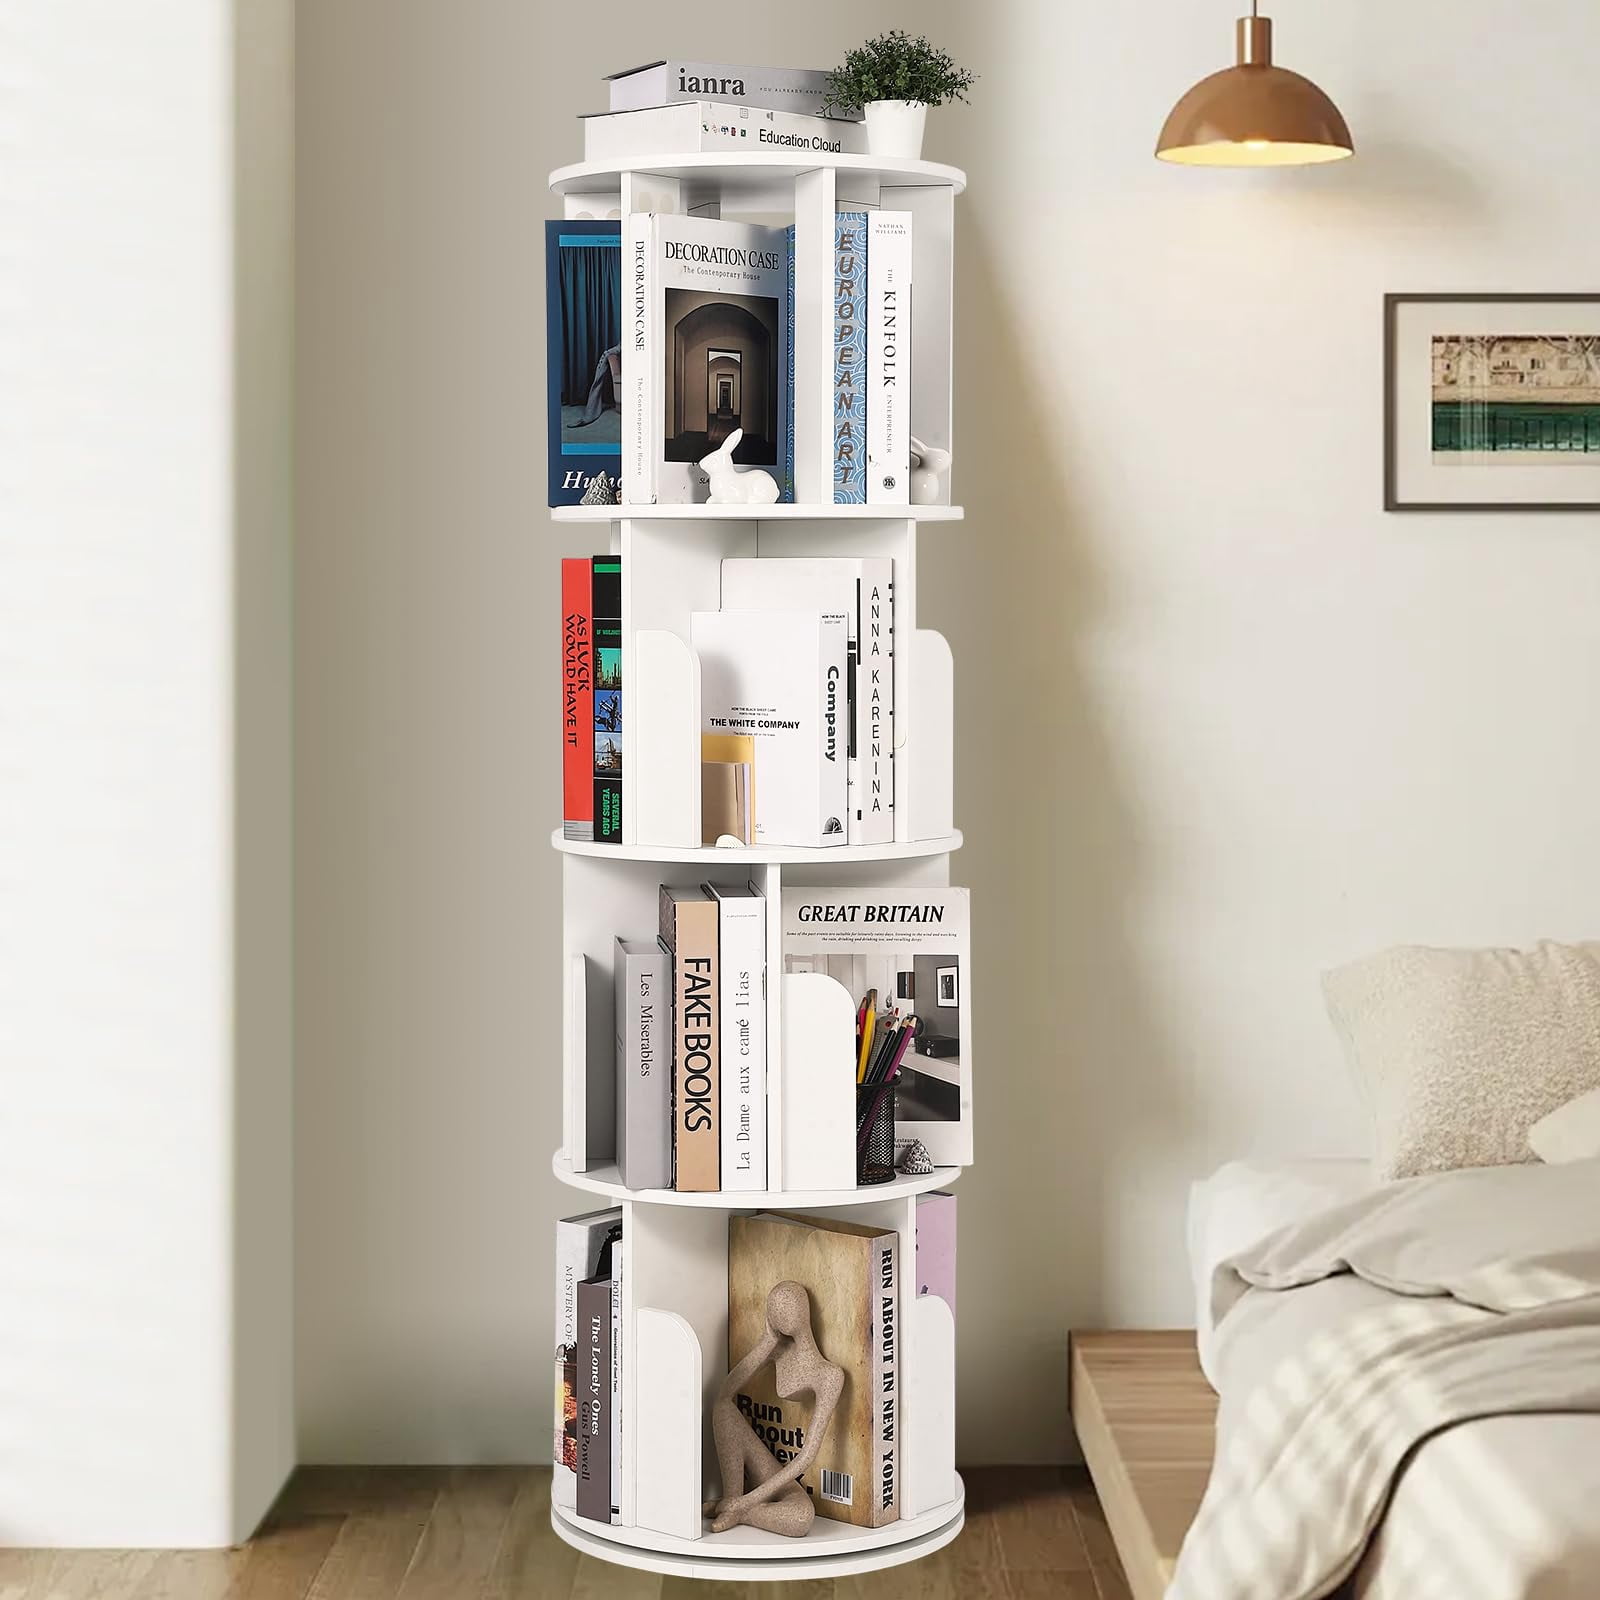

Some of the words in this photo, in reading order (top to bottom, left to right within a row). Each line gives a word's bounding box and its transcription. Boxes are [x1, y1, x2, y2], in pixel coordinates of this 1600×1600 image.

[678, 67, 746, 97] ianra
[759, 128, 810, 150] Education
[812, 135, 842, 154] Cloud
[665, 241, 747, 266] DECORATION
[748, 250, 780, 271] CASE
[683, 265, 695, 274] The
[742, 272, 761, 281] House
[635, 241, 645, 318] DECORATION
[635, 320, 645, 352] CASE
[837, 234, 854, 410] EUROPEAN
[883, 291, 896, 387] KINFOLK
[837, 420, 854, 484] ART
[576, 613, 587, 636] AS
[871, 586, 880, 656] ANNA
[565, 614, 576, 679] WOULD
[577, 640, 590, 692] LUCK
[566, 683, 577, 728] HAVE
[710, 718, 727, 727] THE
[728, 718, 756, 728] WHITE
[758, 720, 800, 730] COMPANY
[825, 665, 839, 763] Company
[567, 732, 578, 748] IT
[871, 669, 881, 813] KARENINA
[602, 788, 611, 817] YEARS
[612, 793, 620, 831] SEVERAL
[602, 817, 611, 836] AGO
[798, 905, 861, 923] GREAT
[863, 905, 945, 923] BRITAIN
[640, 973, 653, 997] Les
[684, 957, 711, 1028] FAKE
[735, 971, 750, 1007] lias
[640, 1005, 653, 1077] Miserables
[735, 1018, 750, 1056] camé
[684, 1034, 712, 1132] BOOKS
[738, 1066, 750, 1094] aux
[736, 1104, 751, 1142] Dame
[736, 1152, 751, 1170] La
[881, 1248, 893, 1289] RUN
[564, 1265, 574, 1323] MYSTERY
[564, 1323, 574, 1340] OF
[591, 1315, 601, 1343] The
[882, 1297, 894, 1364] ABOUT
[589, 1346, 601, 1396] Lonely
[882, 1371, 894, 1393] IN
[581, 1401, 590, 1429] Gus
[591, 1399, 601, 1436] Ones
[737, 1394, 783, 1424] Run
[882, 1398, 894, 1442] NEW
[750, 1417, 805, 1448] bout
[581, 1433, 591, 1481] Powell
[882, 1449, 894, 1511] YORK
